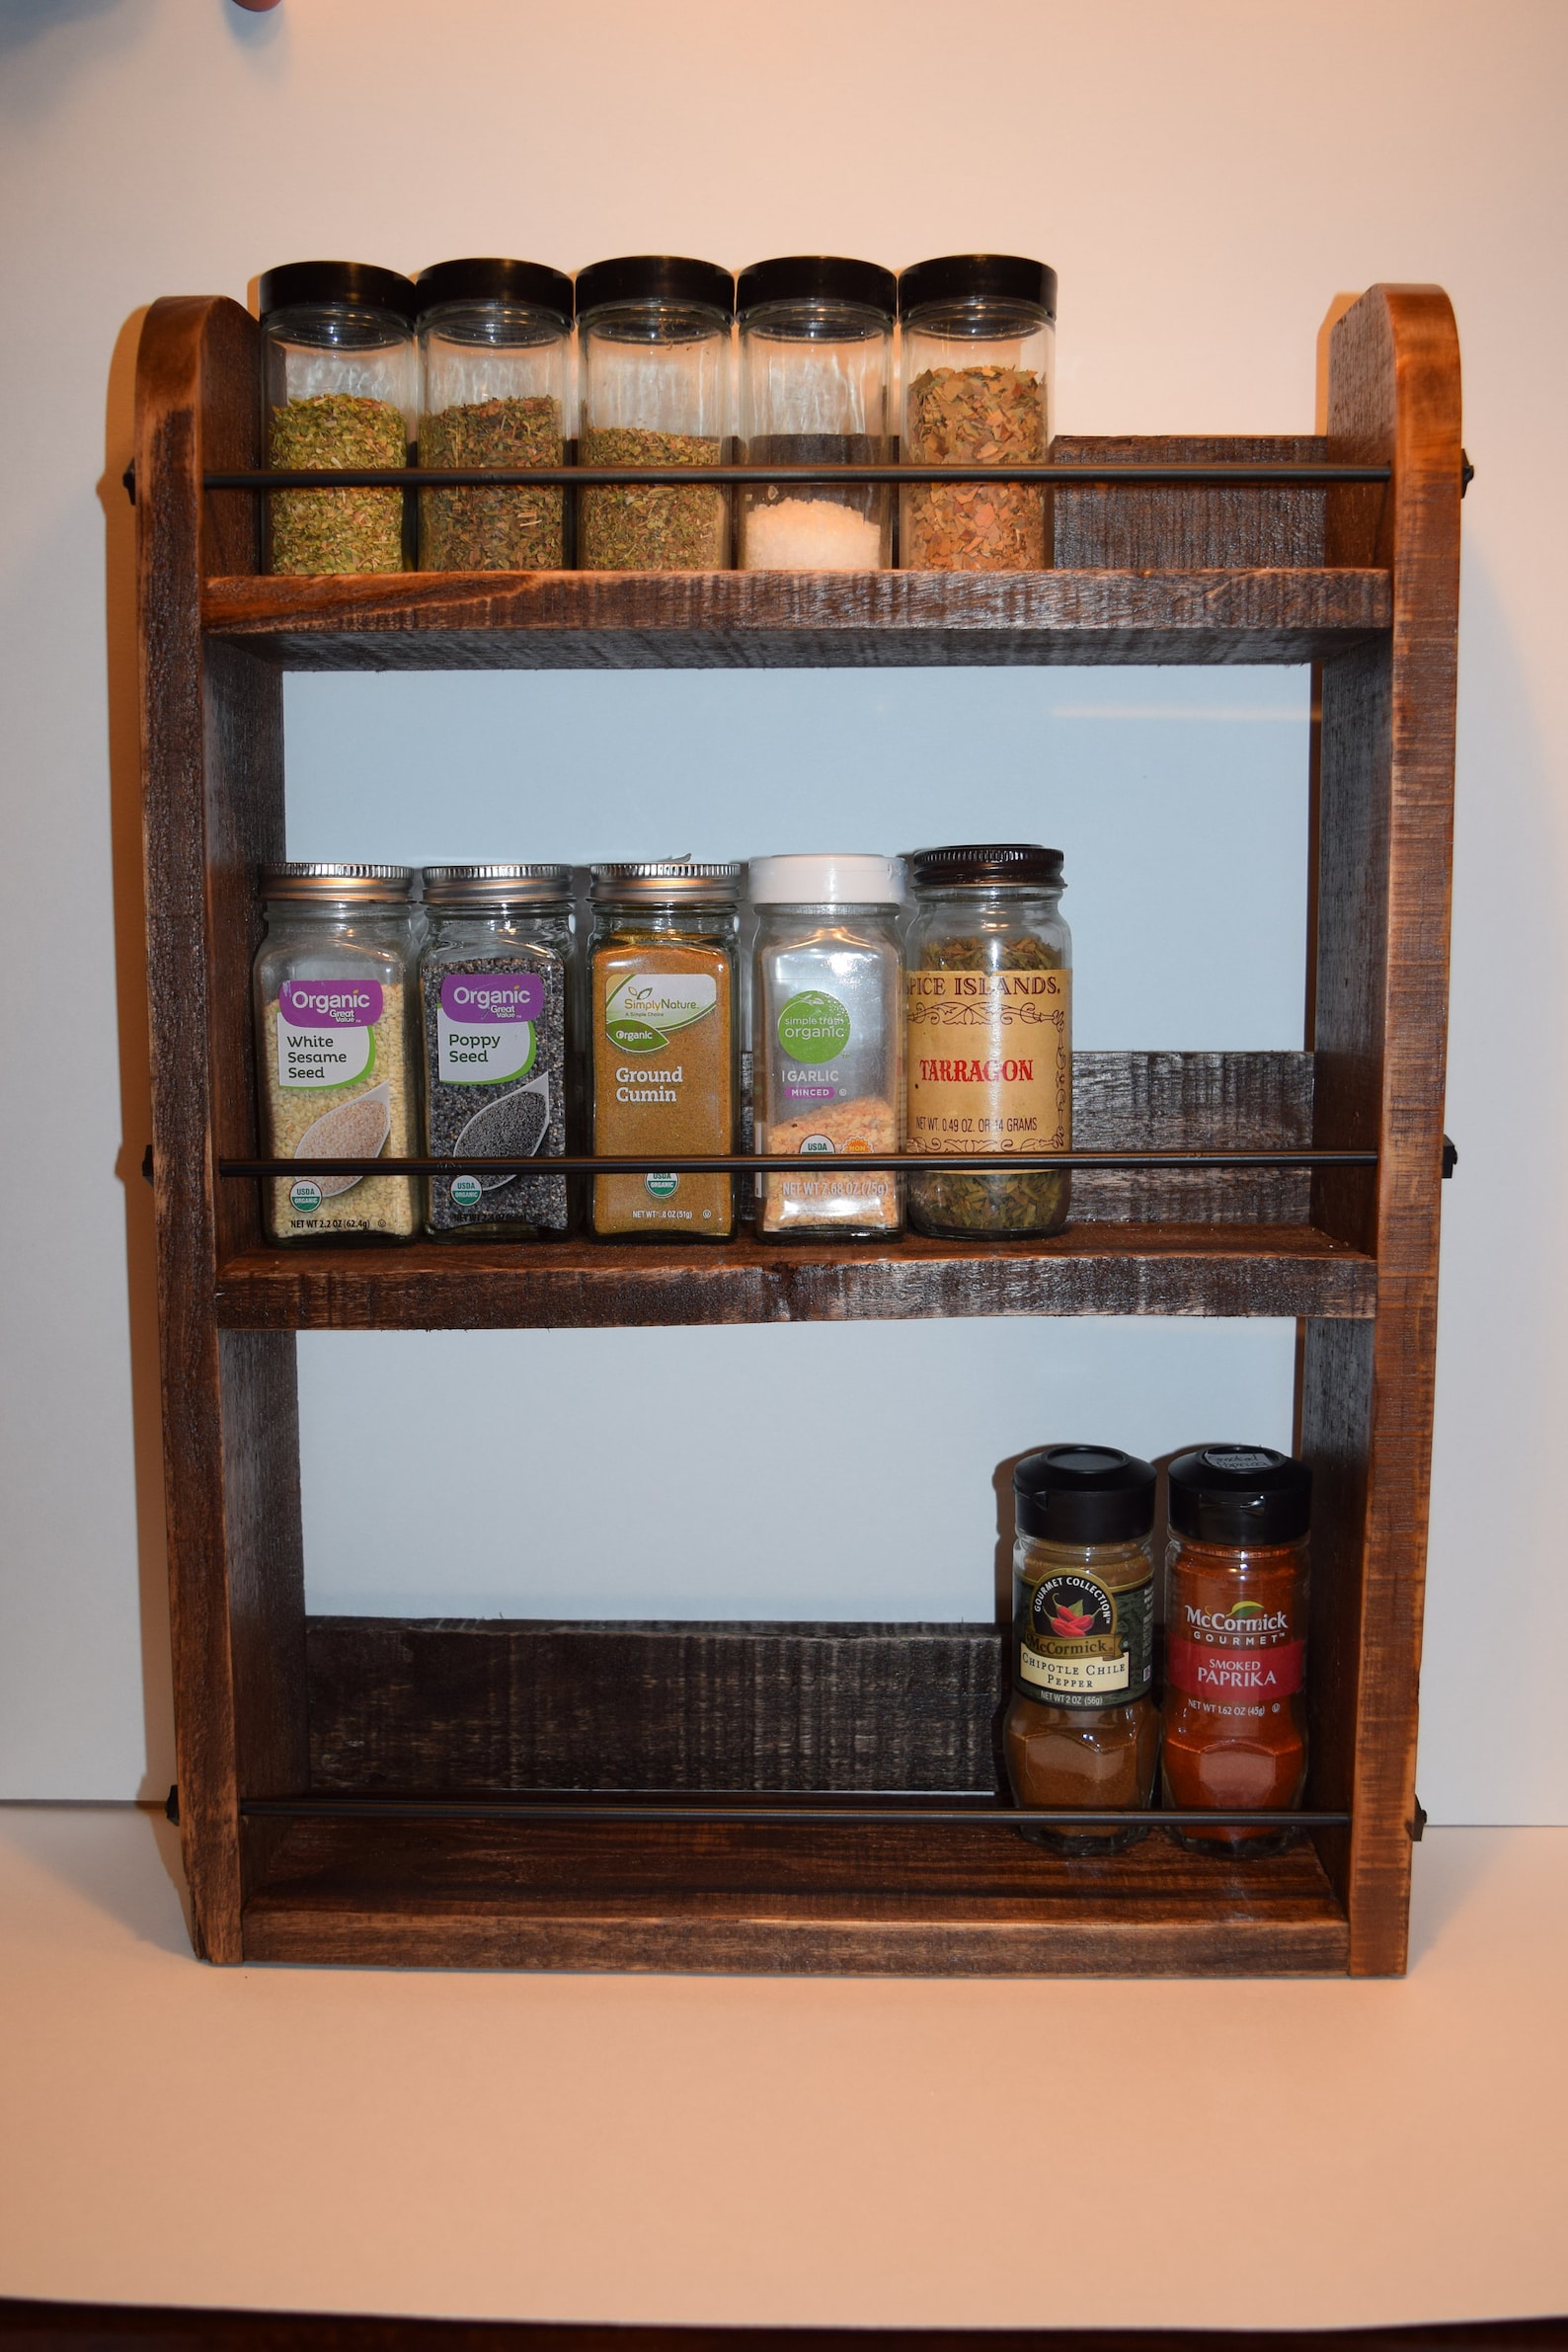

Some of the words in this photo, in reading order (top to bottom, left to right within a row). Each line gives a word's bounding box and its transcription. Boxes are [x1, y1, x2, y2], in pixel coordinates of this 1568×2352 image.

[291, 989, 370, 1014] Organic
[454, 985, 531, 1009] Organic
[624, 998, 697, 1010] SimplyNature
[329, 1009, 355, 1018] Great
[784, 1017, 818, 1026] simple
[615, 1030, 654, 1042] Organic
[784, 1025, 845, 1041] organic
[286, 1035, 334, 1048] White
[448, 1033, 502, 1049] Poppy
[287, 1052, 348, 1063] Sesame
[448, 1050, 489, 1063] Seed
[287, 1066, 326, 1079] Seed
[615, 1066, 683, 1083] Ground
[786, 1069, 840, 1082] GARLIC
[919, 1058, 1035, 1082] TARRAGON
[615, 1085, 677, 1103] Cumin
[790, 1088, 830, 1097] MINCED
[915, 1117, 926, 1130] NET
[942, 1118, 959, 1133] 0.49
[1006, 1117, 1038, 1133] GRAMS
[807, 1142, 827, 1151] USDA
[782, 1181, 802, 1196] NET
[803, 1181, 820, 1195] WT
[822, 1182, 844, 1195] 2.68
[845, 1182, 859, 1195] OZ
[861, 1181, 889, 1197] (75g)
[676, 1211, 692, 1219] (51g)
[344, 1219, 370, 1229] (62.4g)
[1034, 1577, 1064, 1612] GOURMET
[1066, 1577, 1111, 1619] COLLECTION
[1185, 1605, 1289, 1631] McCormick
[1194, 1631, 1278, 1646] GOURMET
[1210, 1659, 1261, 1671] SMOKED
[1198, 1667, 1277, 1686] PAPRIKA
[1041, 1690, 1053, 1699] NET
[1054, 1693, 1065, 1703] WT
[1084, 1696, 1103, 1706] (56g)
[1188, 1698, 1202, 1709] NET
[1203, 1703, 1215, 1713] WT
[1217, 1705, 1232, 1715] 1.62
[1233, 1706, 1245, 1716] OZ
[1247, 1706, 1265, 1717] (45g)
